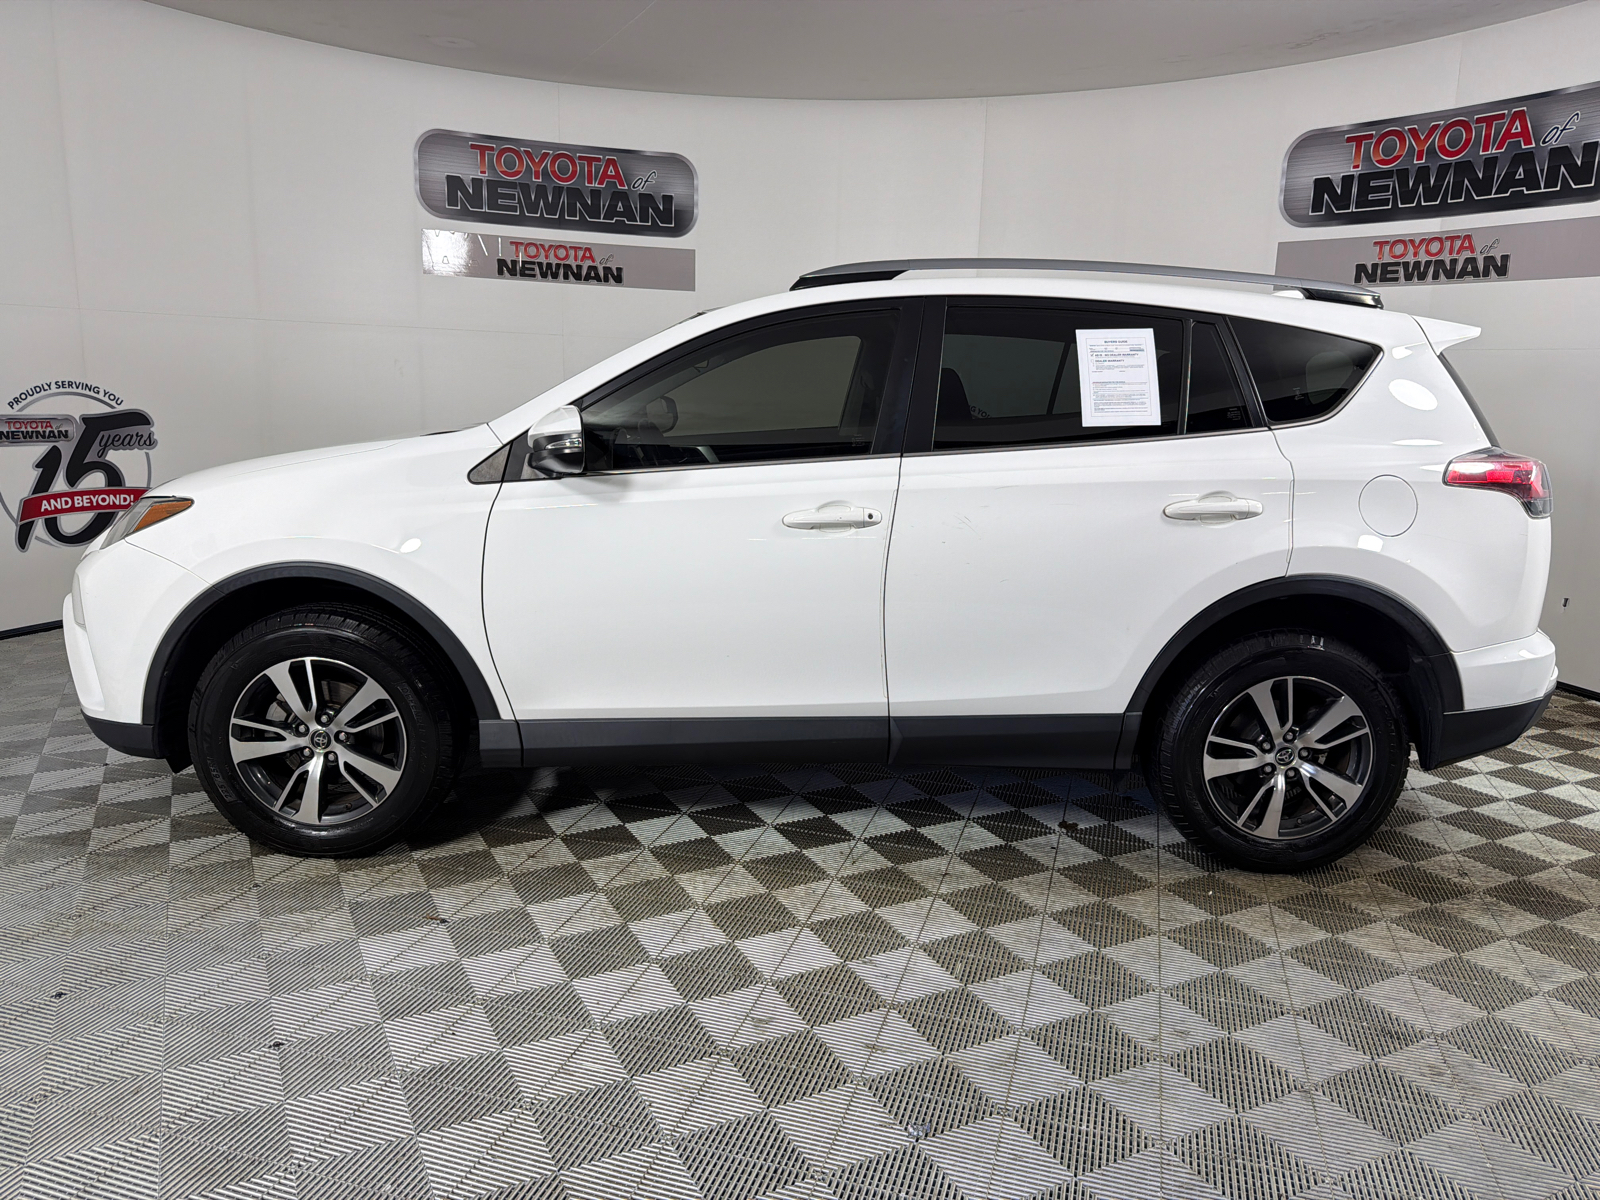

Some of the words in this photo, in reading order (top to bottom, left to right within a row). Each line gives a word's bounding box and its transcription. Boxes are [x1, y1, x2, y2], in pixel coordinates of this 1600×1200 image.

[1345, 107, 1535, 171] TOYOTA
[1540, 111, 1580, 146] of
[469, 142, 627, 189] TOYOTA
[631, 170, 657, 191] of
[1309, 139, 1600, 216] NEWNAN
[445, 174, 675, 228] NEWNAN
[509, 240, 596, 264] TOYOTA
[599, 253, 613, 265] of
[1373, 233, 1475, 260] TOYOTA
[1480, 238, 1500, 255] of
[496, 258, 623, 284] NEWNAN
[1354, 253, 1511, 285] NEWNAN
[7, 381, 52, 410] PROUDLY
[54, 380, 100, 395] SERVING
[103, 389, 124, 406] YOU
[0, 429, 69, 440] NEWNAN
[5, 420, 53, 430] TOYOTA
[97, 430, 156, 459] years
[41, 498, 72, 512] AND
[74, 494, 134, 509] BEYOND!
